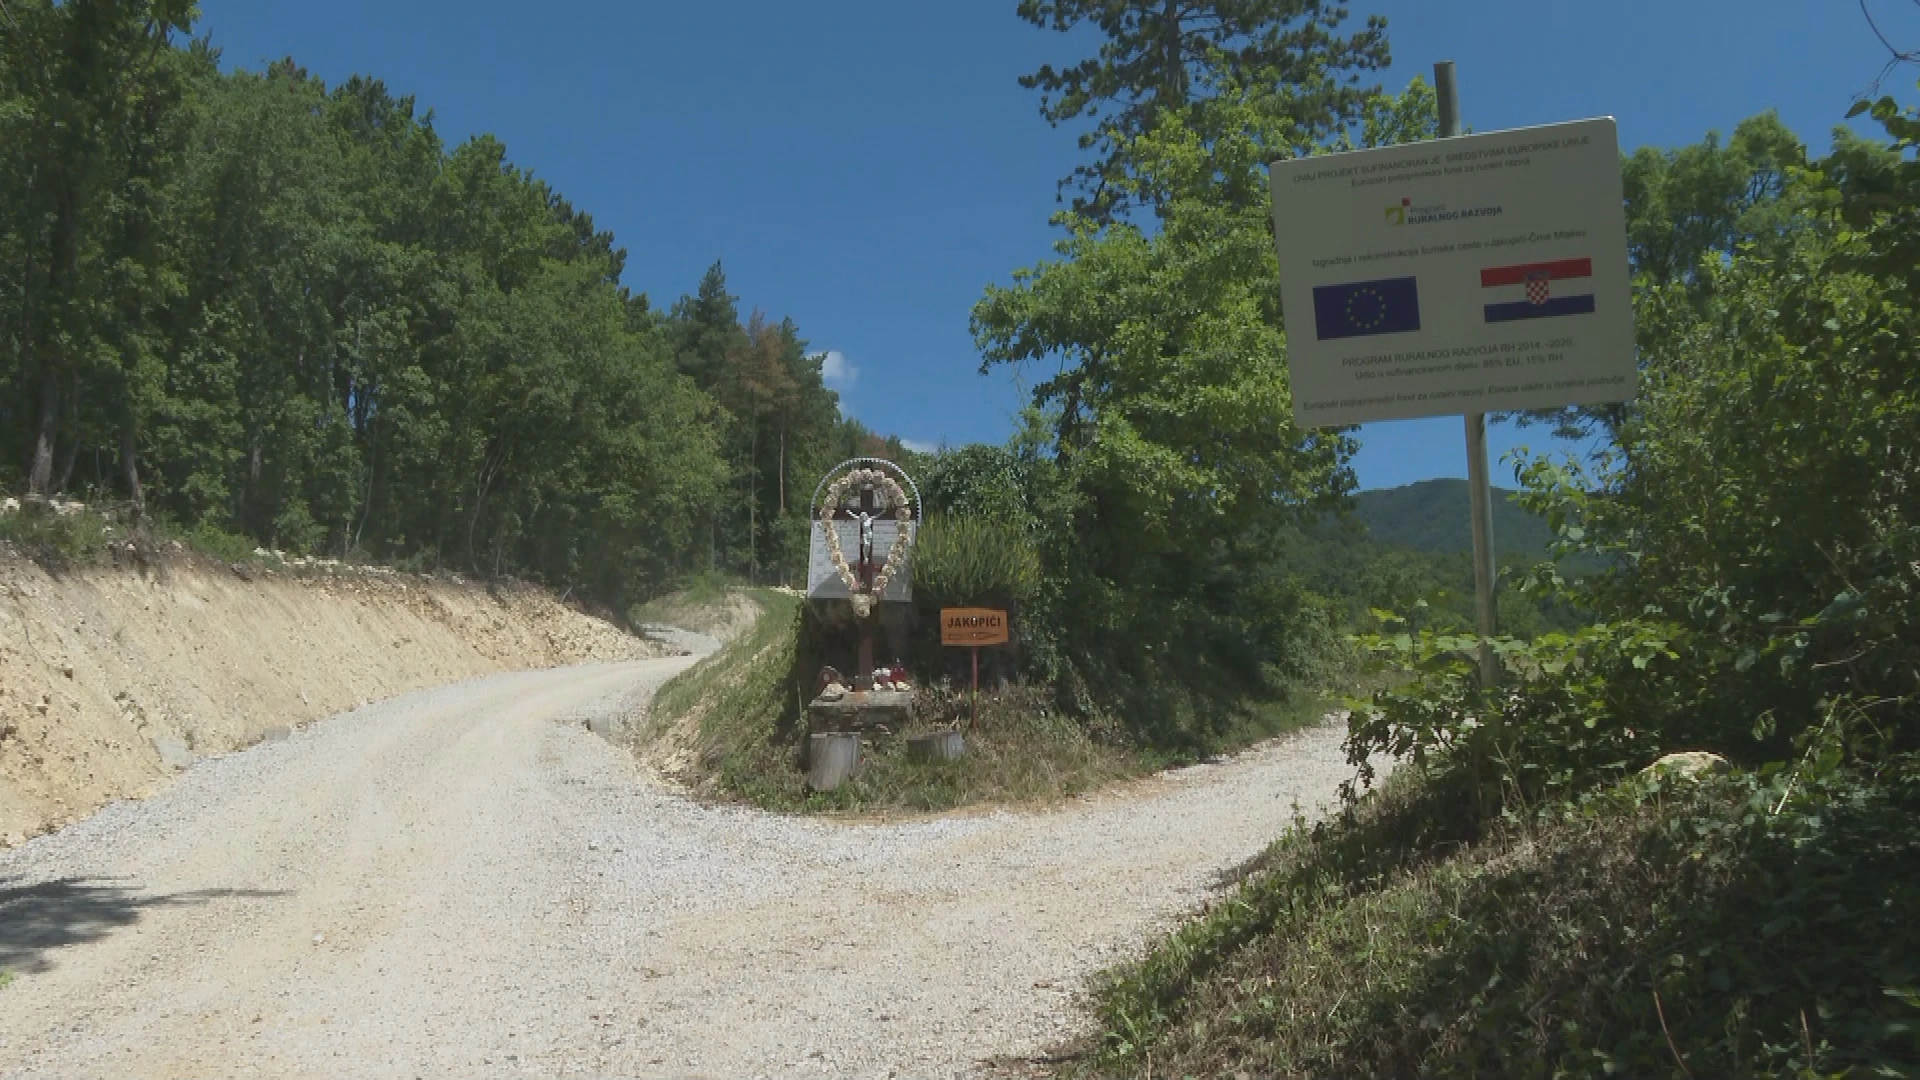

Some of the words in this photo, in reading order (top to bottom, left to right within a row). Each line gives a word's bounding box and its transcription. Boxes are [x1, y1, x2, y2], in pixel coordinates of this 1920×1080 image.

[1317, 167, 1358, 179] PROJEKT
[1361, 158, 1428, 173] SUFINANCIRAN
[1430, 156, 1440, 165] JE
[1446, 149, 1506, 162] SREDSTVIMA
[1507, 140, 1559, 154] EUROPSKE
[1562, 136, 1589, 148] UNIJE
[1408, 211, 1458, 224] RURALNOG
[1461, 206, 1503, 218] RAZVOJA
[1342, 355, 1392, 367] PROGRAM
[1394, 349, 1450, 361] RURALNOG
[1452, 344, 1498, 356] RAZVOJA
[1500, 343, 1515, 352] RH
[1548, 353, 1563, 361] RH
